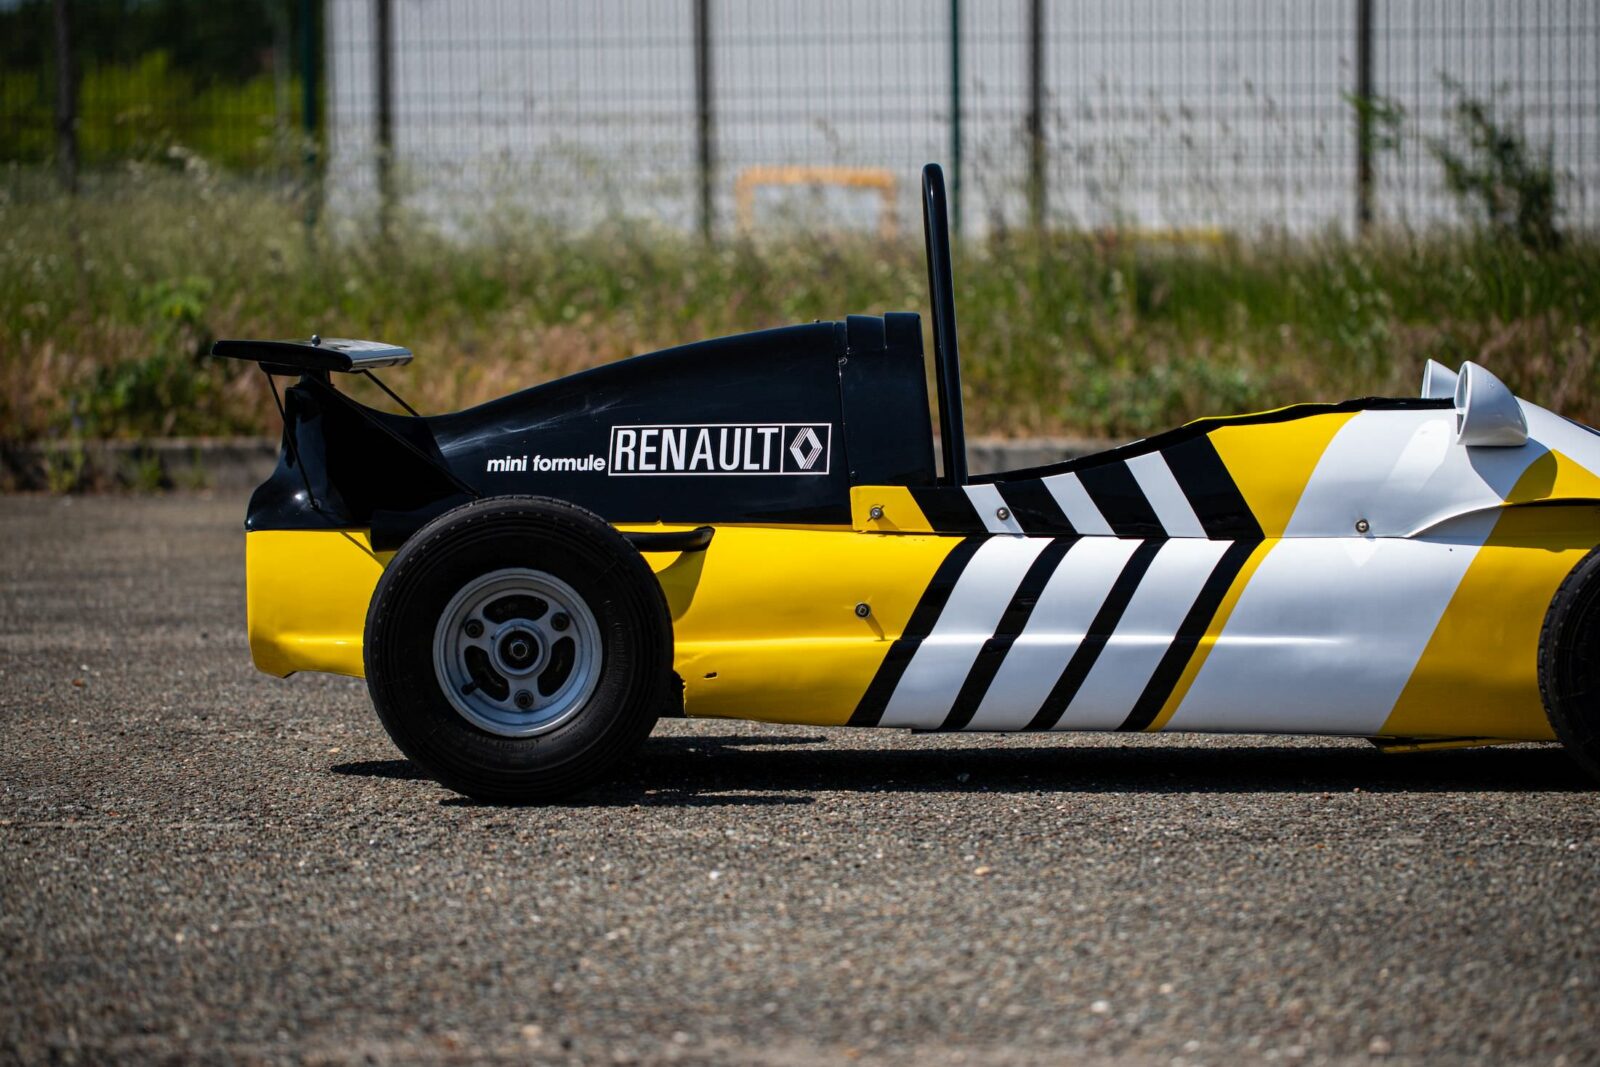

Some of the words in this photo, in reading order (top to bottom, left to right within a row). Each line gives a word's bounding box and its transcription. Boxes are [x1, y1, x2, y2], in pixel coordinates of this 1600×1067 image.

[486, 455, 528, 472] mini
[532, 454, 606, 472] formule
[614, 427, 780, 471] RENAULT
